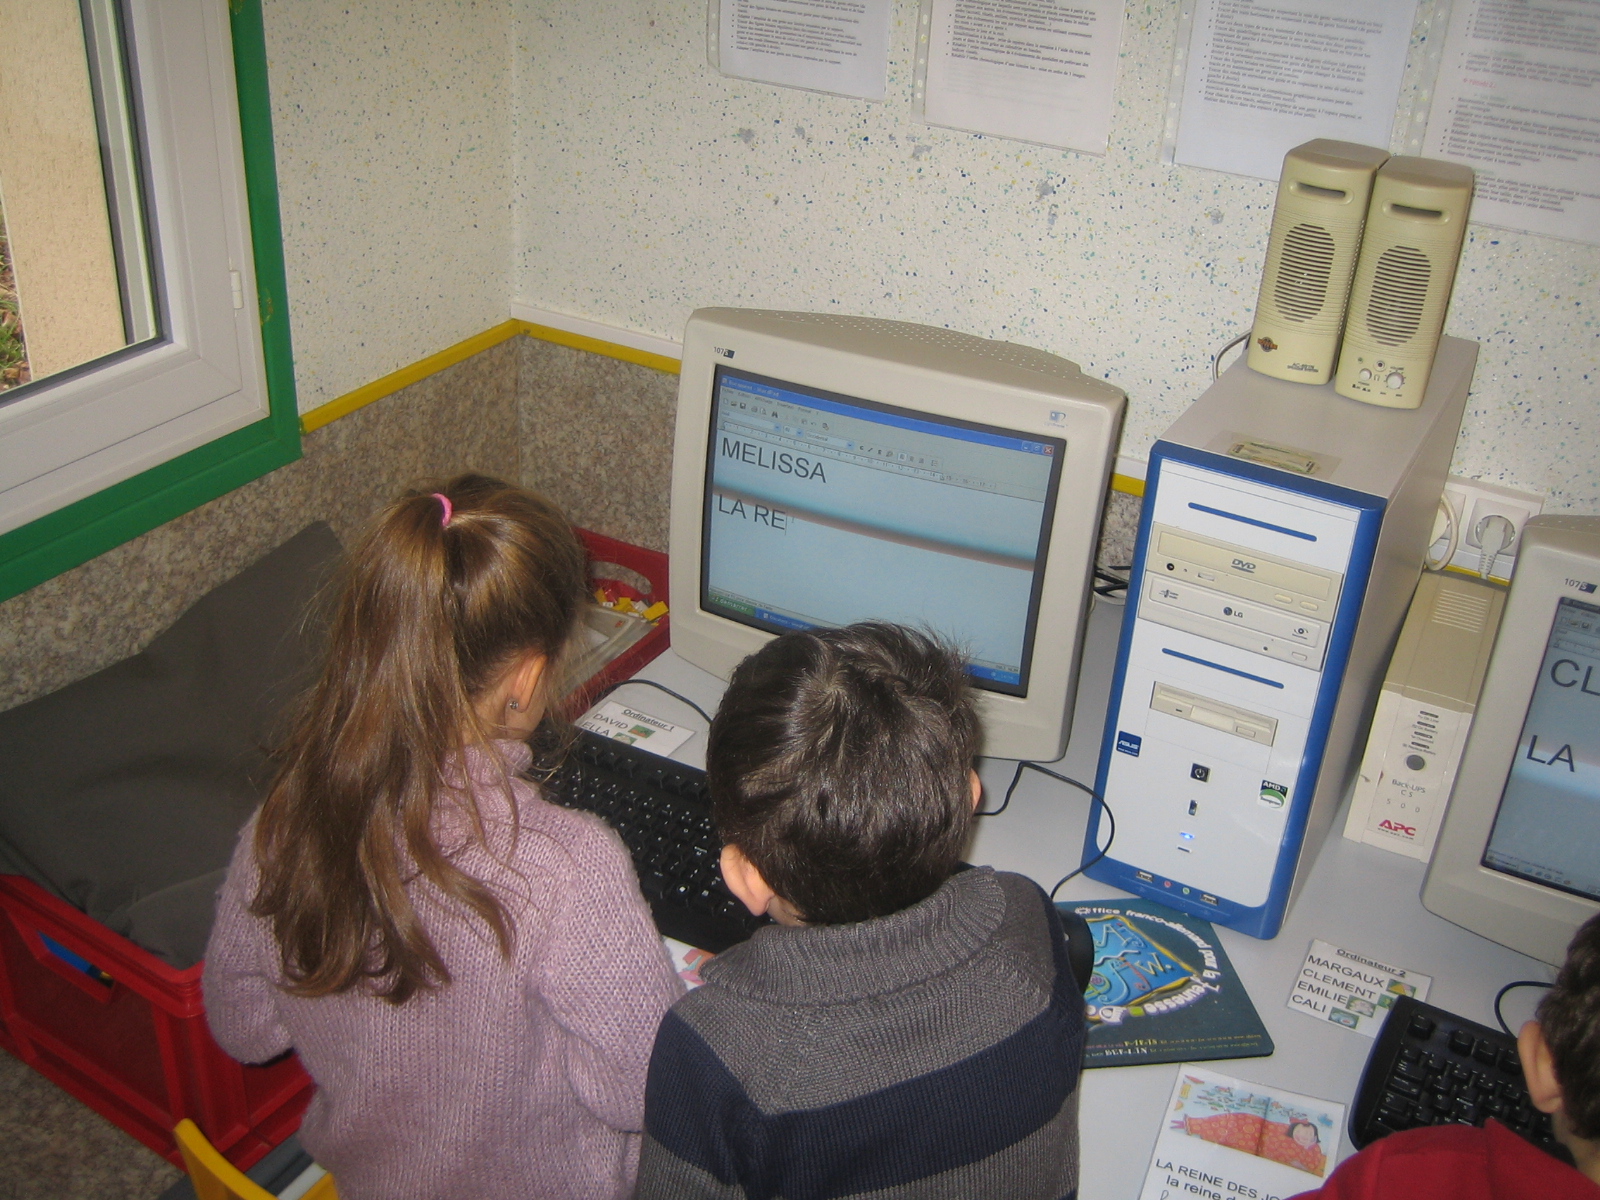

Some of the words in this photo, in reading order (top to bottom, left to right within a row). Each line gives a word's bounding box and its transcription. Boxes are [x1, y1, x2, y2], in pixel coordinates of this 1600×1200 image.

[722, 437, 827, 484] MELISSA
[718, 493, 747, 520] LA
[754, 504, 786, 531] RE
[1231, 558, 1256, 570] DVD
[1233, 610, 1244, 619] LG
[581, 720, 610, 737] ELLA
[593, 713, 629, 730] DAVID
[622, 708, 669, 731] Ordinateur
[1526, 734, 1575, 773] LA
[1262, 781, 1281, 791] AMD
[1391, 778, 1426, 794] Back-UPS
[1378, 819, 1417, 837] APC
[1307, 954, 1385, 988] MARGAUX
[1335, 948, 1396, 974] Ordinateur
[1297, 980, 1349, 1005] EMILIE
[1302, 968, 1376, 999] CLEMENT
[1292, 994, 1327, 1013] CALI
[1155, 1158, 1173, 1171] LA
[1178, 1165, 1224, 1187] REINE
[1226, 1181, 1258, 1199] DES
[1165, 1175, 1180, 1188] la
[1183, 1182, 1222, 1200] reine
